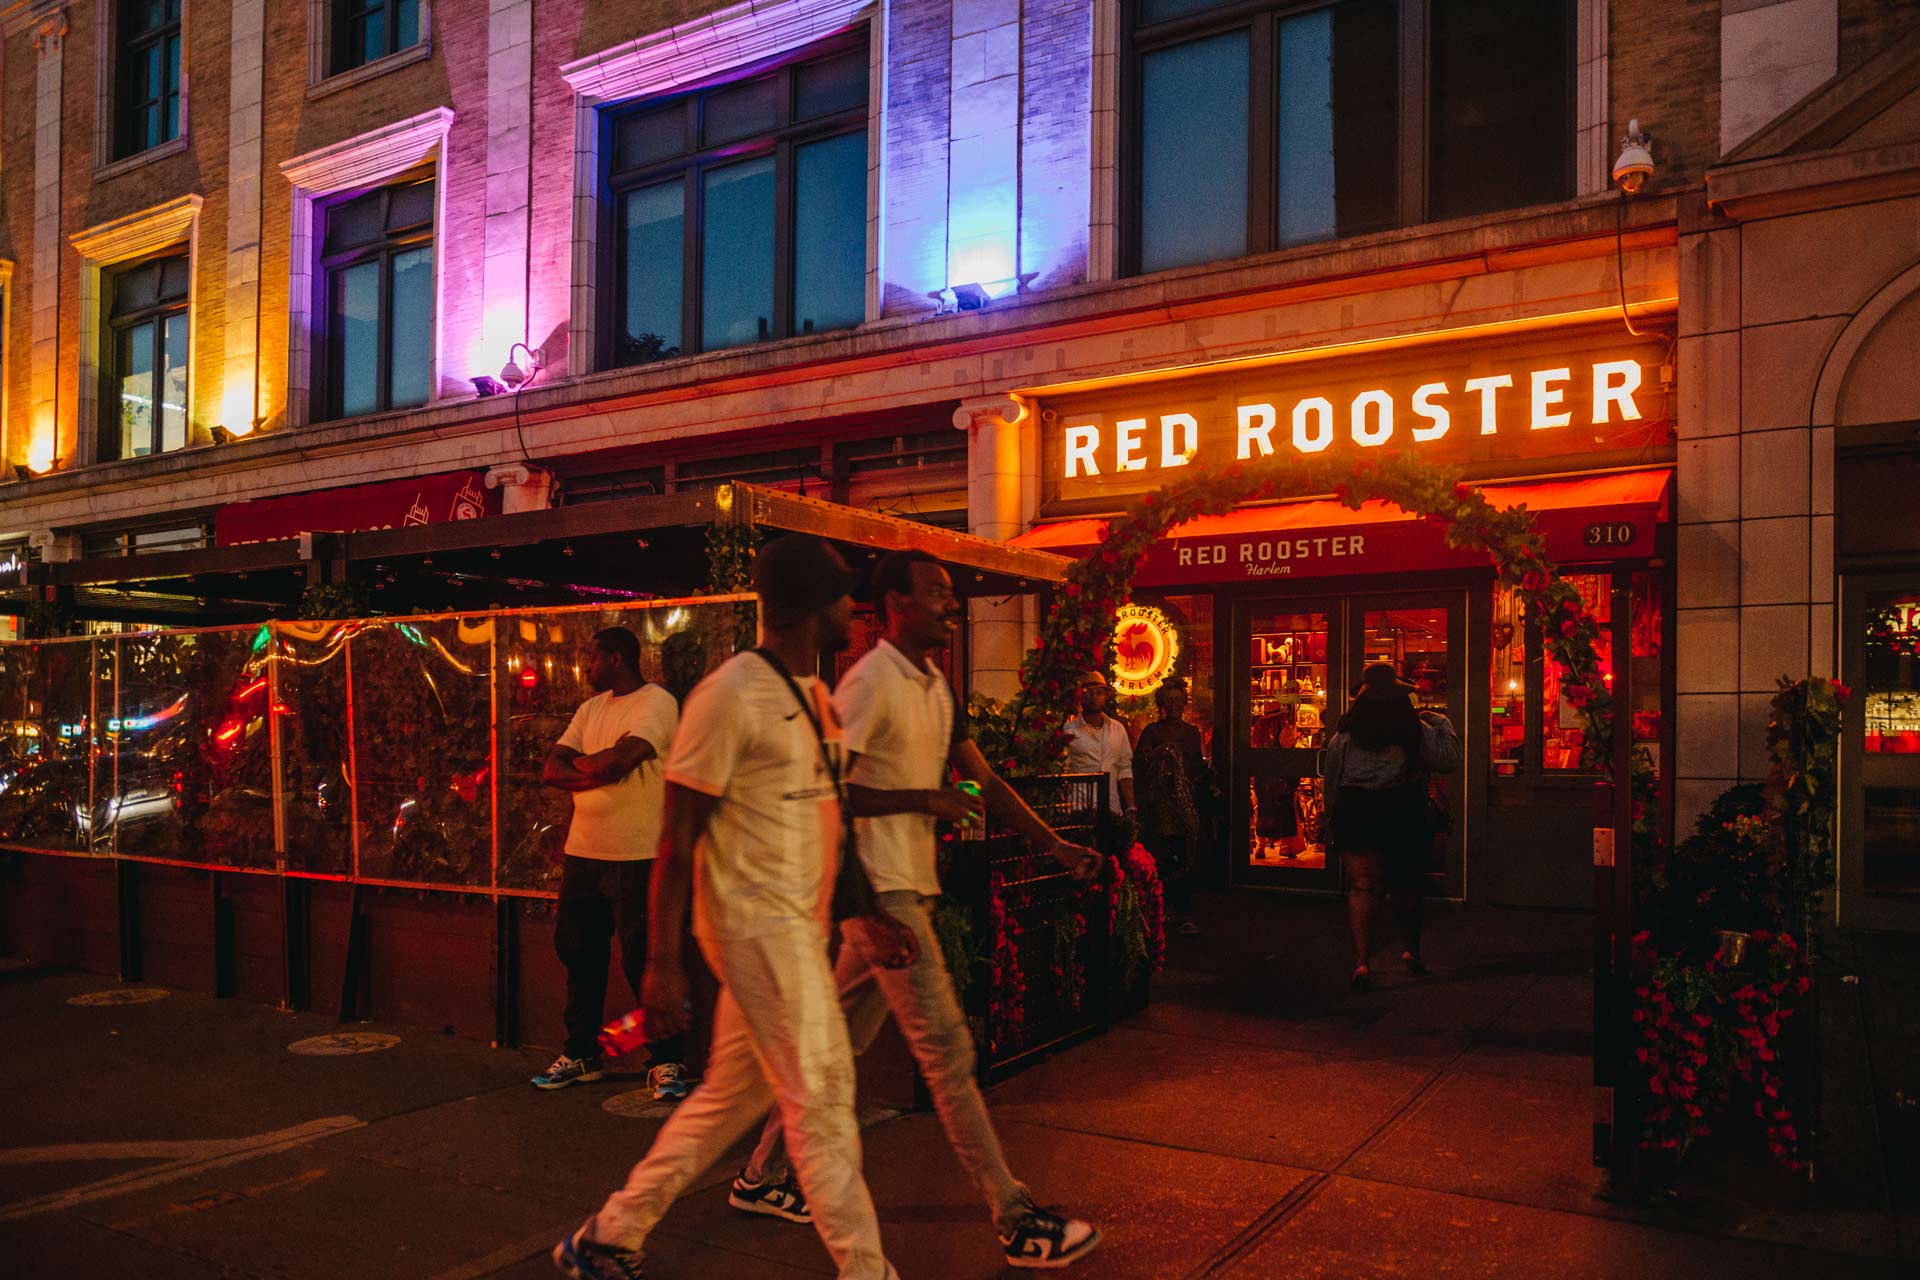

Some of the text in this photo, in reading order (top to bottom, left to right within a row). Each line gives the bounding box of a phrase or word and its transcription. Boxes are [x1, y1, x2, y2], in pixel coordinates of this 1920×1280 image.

[1064, 359, 1643, 478] RED ROOSTER
[1589, 525, 1630, 544] 310
[1179, 535, 1365, 566] RED ROOSTER
[1245, 561, 1291, 576] Harlem
[1121, 608, 1169, 635] ROOSTER
[1115, 671, 1163, 690] ARLEM
